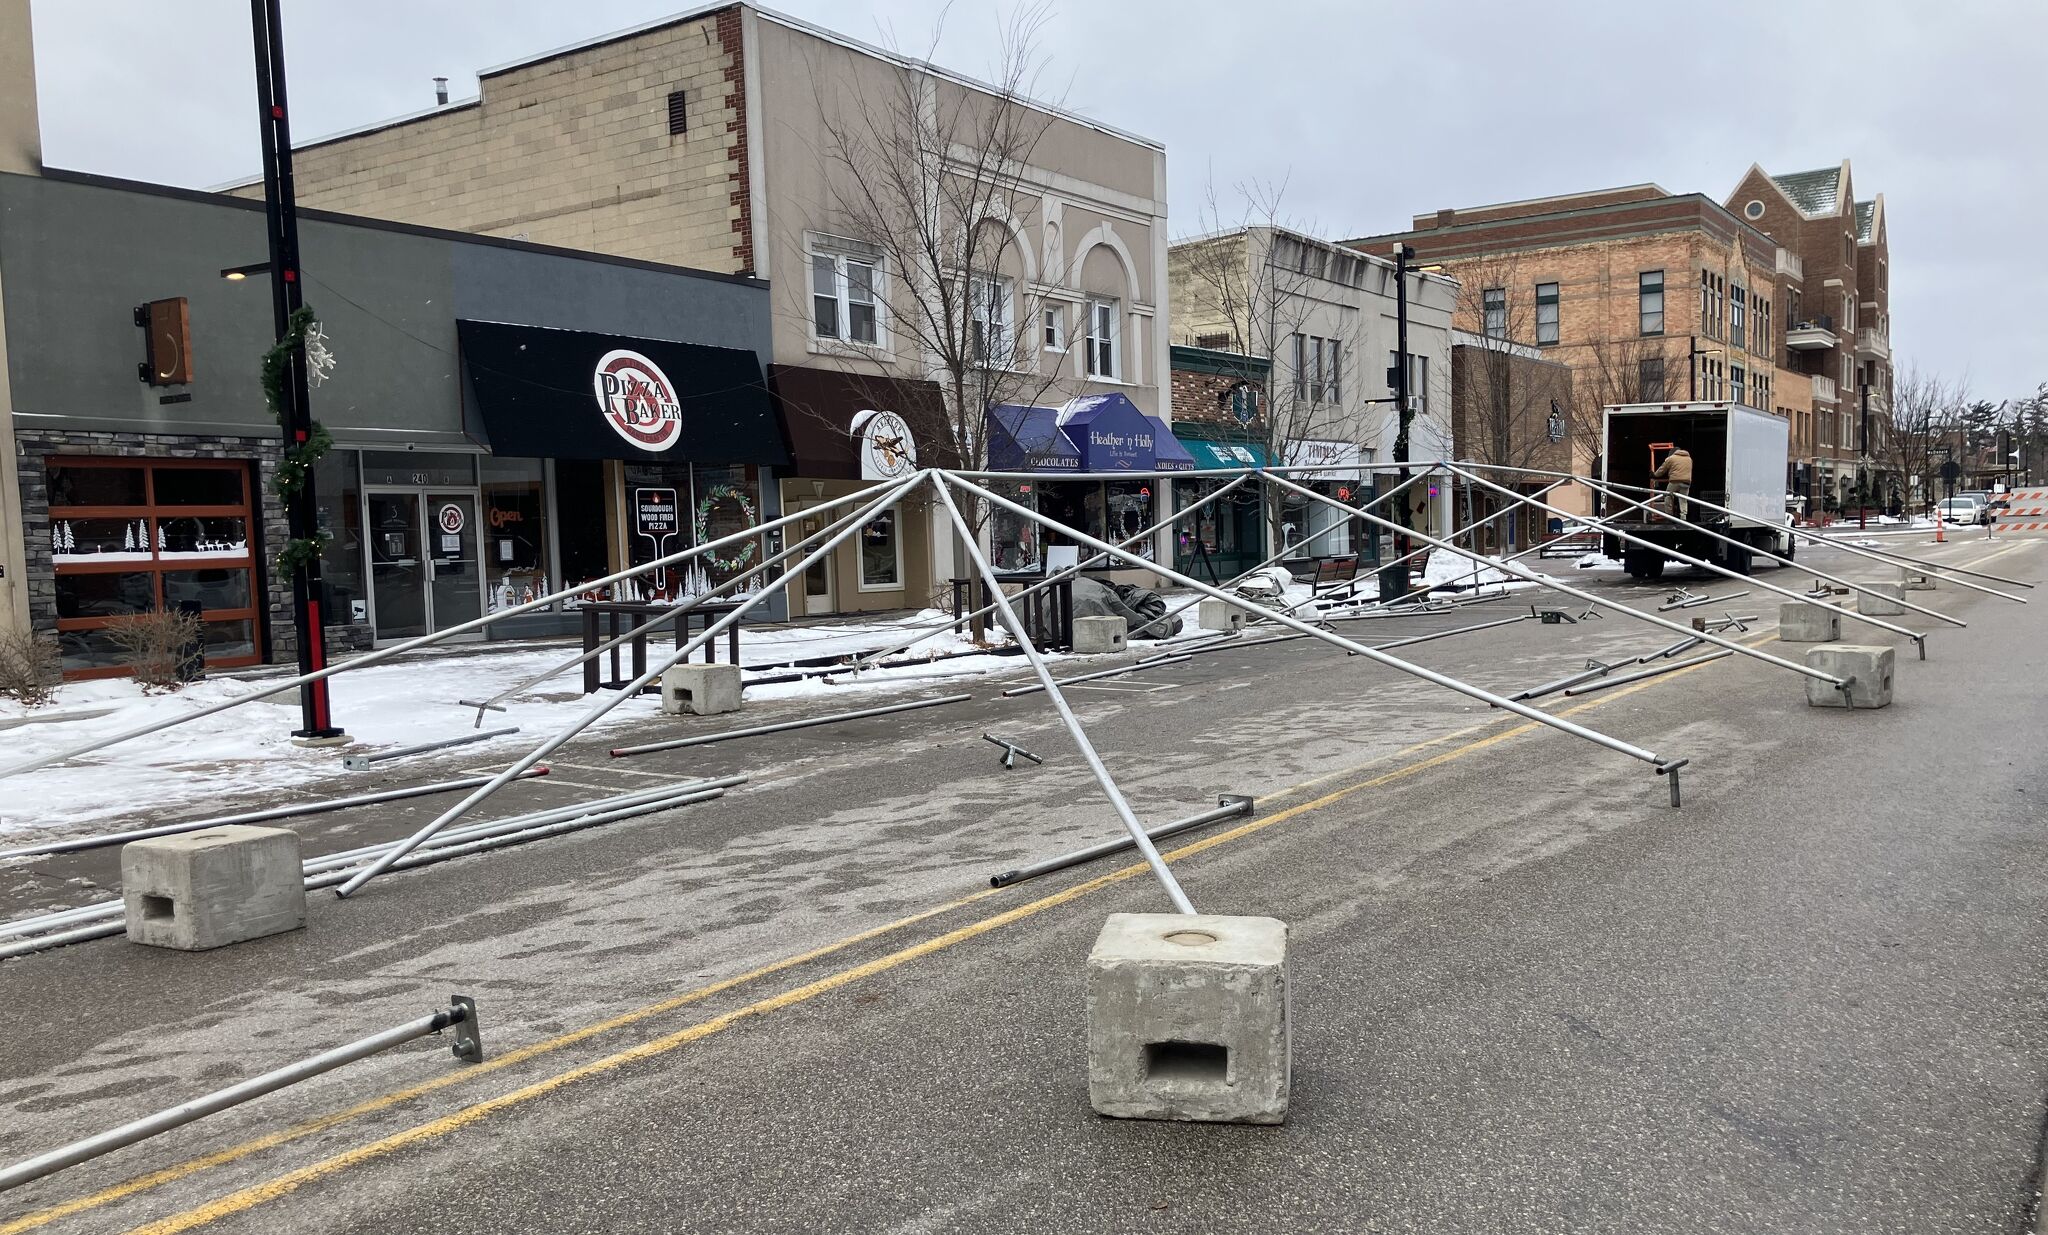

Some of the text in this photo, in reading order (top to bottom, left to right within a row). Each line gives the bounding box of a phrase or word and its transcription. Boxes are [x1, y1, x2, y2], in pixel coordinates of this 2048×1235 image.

[598, 373, 666, 414] PIZZA
[624, 398, 681, 424] BAKER
[1090, 431, 1124, 449] Heather
[1135, 433, 1154, 452] Holly
[1030, 457, 1079, 468] CHOCOLATES
[412, 472, 428, 484] 240
[640, 504, 673, 512] SOURDOUGH
[489, 507, 524, 528] Open
[640, 513, 674, 521] WOOD FIRED
[648, 522, 668, 530] PIZZA
